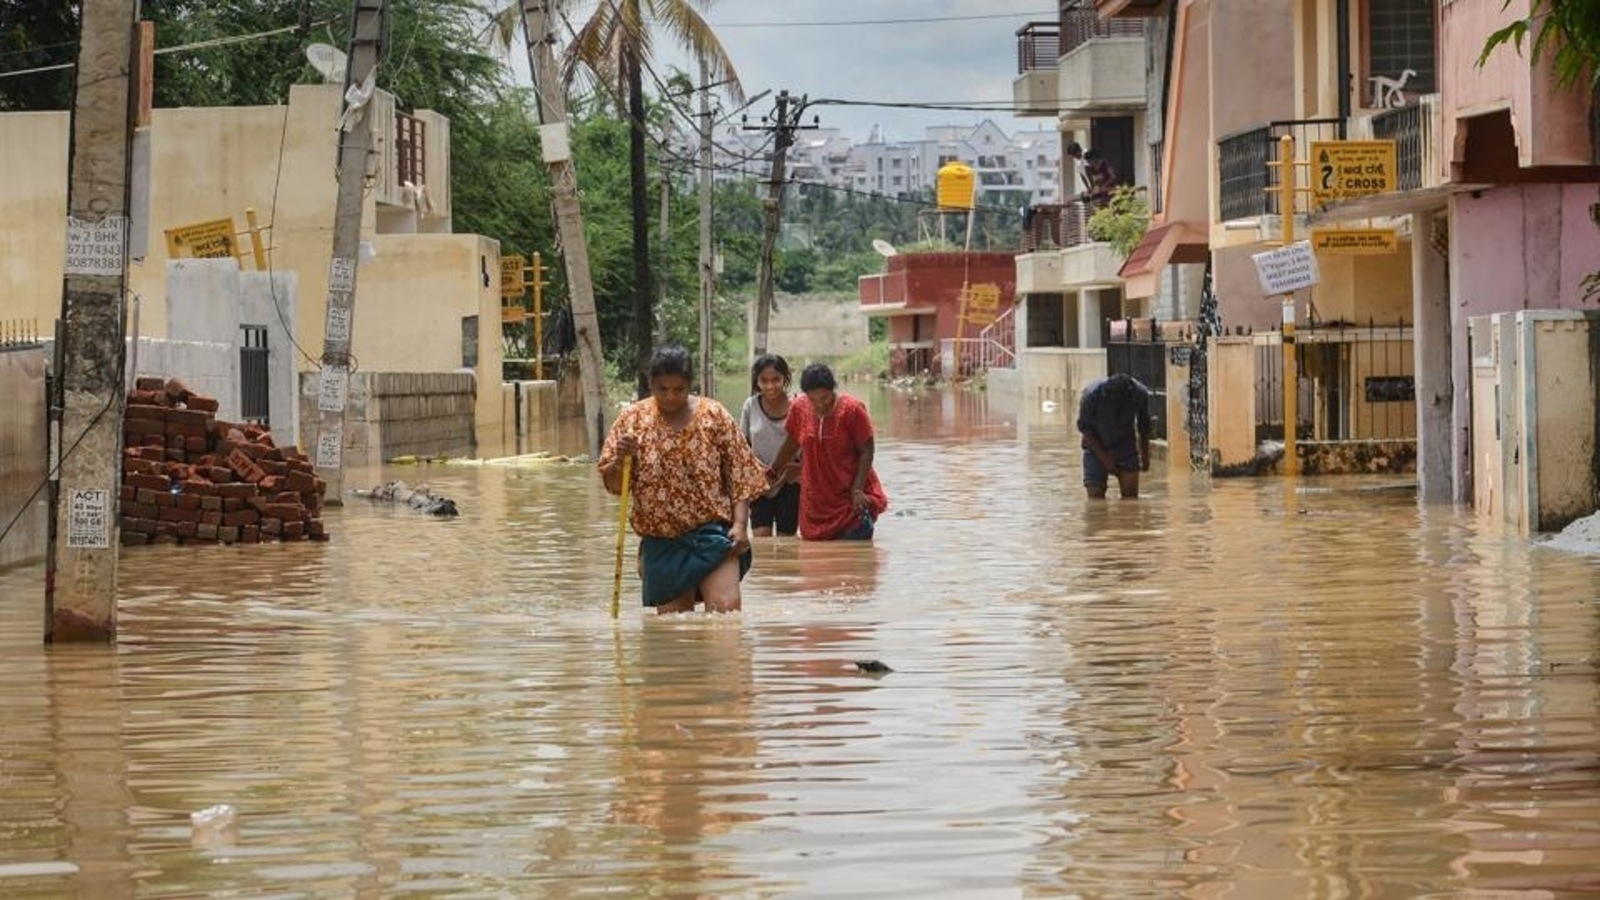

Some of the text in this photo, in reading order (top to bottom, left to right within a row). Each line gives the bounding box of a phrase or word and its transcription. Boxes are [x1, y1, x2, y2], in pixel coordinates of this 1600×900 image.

[1346, 178, 1386, 189] CROSS
[84, 231, 91, 242] 2
[94, 231, 119, 242] BHK
[75, 491, 102, 501] ACT
